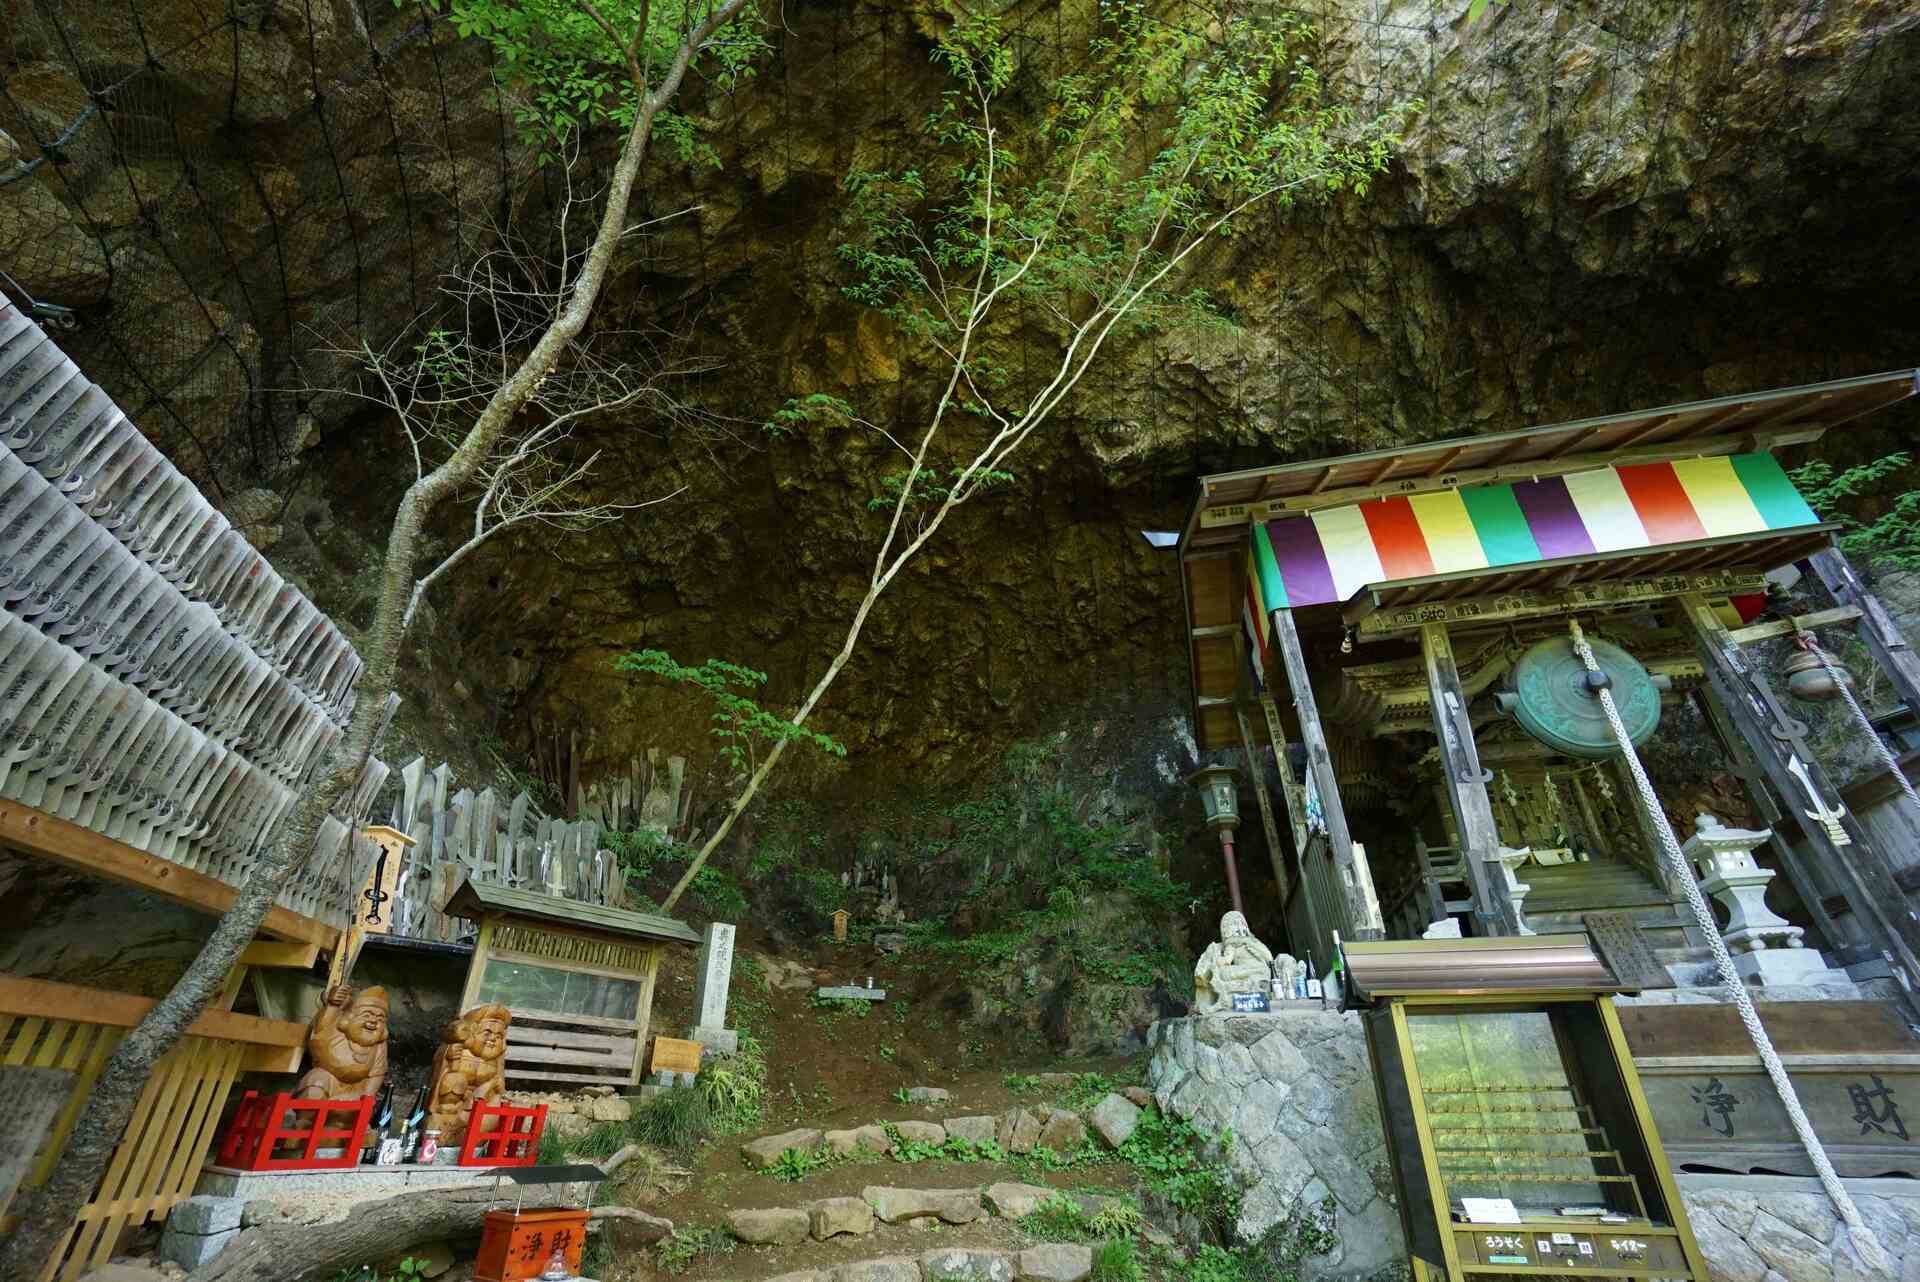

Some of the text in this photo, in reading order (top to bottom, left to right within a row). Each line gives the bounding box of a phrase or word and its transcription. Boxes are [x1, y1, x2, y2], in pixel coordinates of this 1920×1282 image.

[1847, 1073, 1909, 1141] 財
[1485, 1235, 1524, 1249] ろうそく
[1610, 1239, 1648, 1251] ライター
